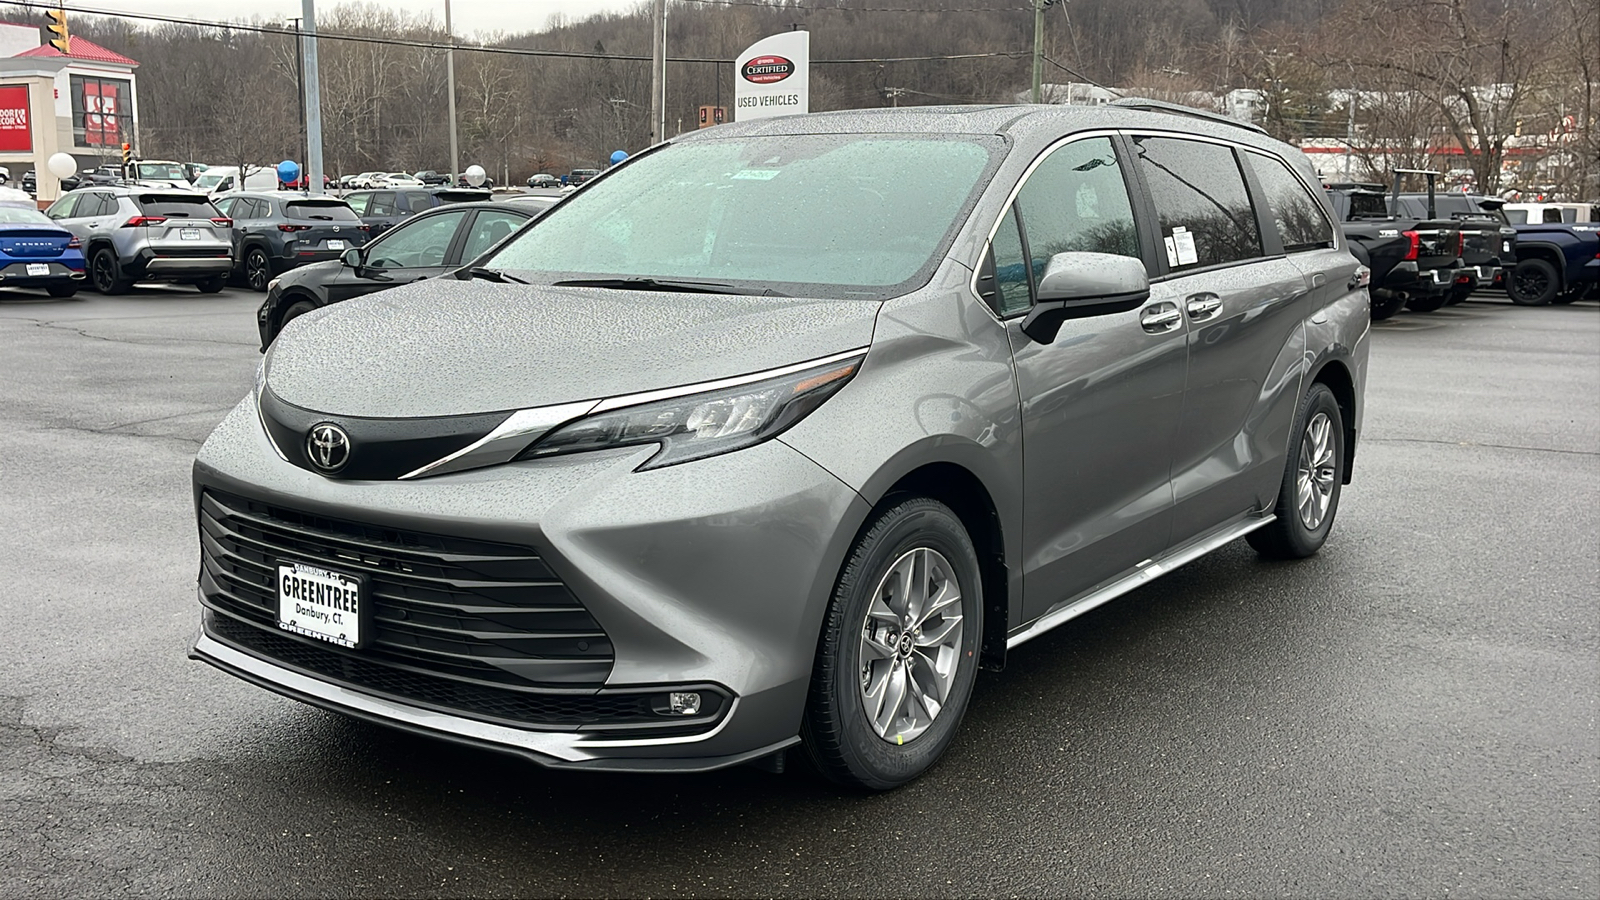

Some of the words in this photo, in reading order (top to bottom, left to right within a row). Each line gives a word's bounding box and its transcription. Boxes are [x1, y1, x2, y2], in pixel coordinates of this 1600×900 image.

[747, 66, 788, 75] CERTIFIED
[738, 96, 757, 108] USED
[759, 94, 799, 107] VEHICLES
[283, 574, 357, 613] GREENTREE
[295, 602, 331, 625] Danbury,
[332, 612, 344, 626] CT.
[279, 623, 355, 648] GREENTREE
